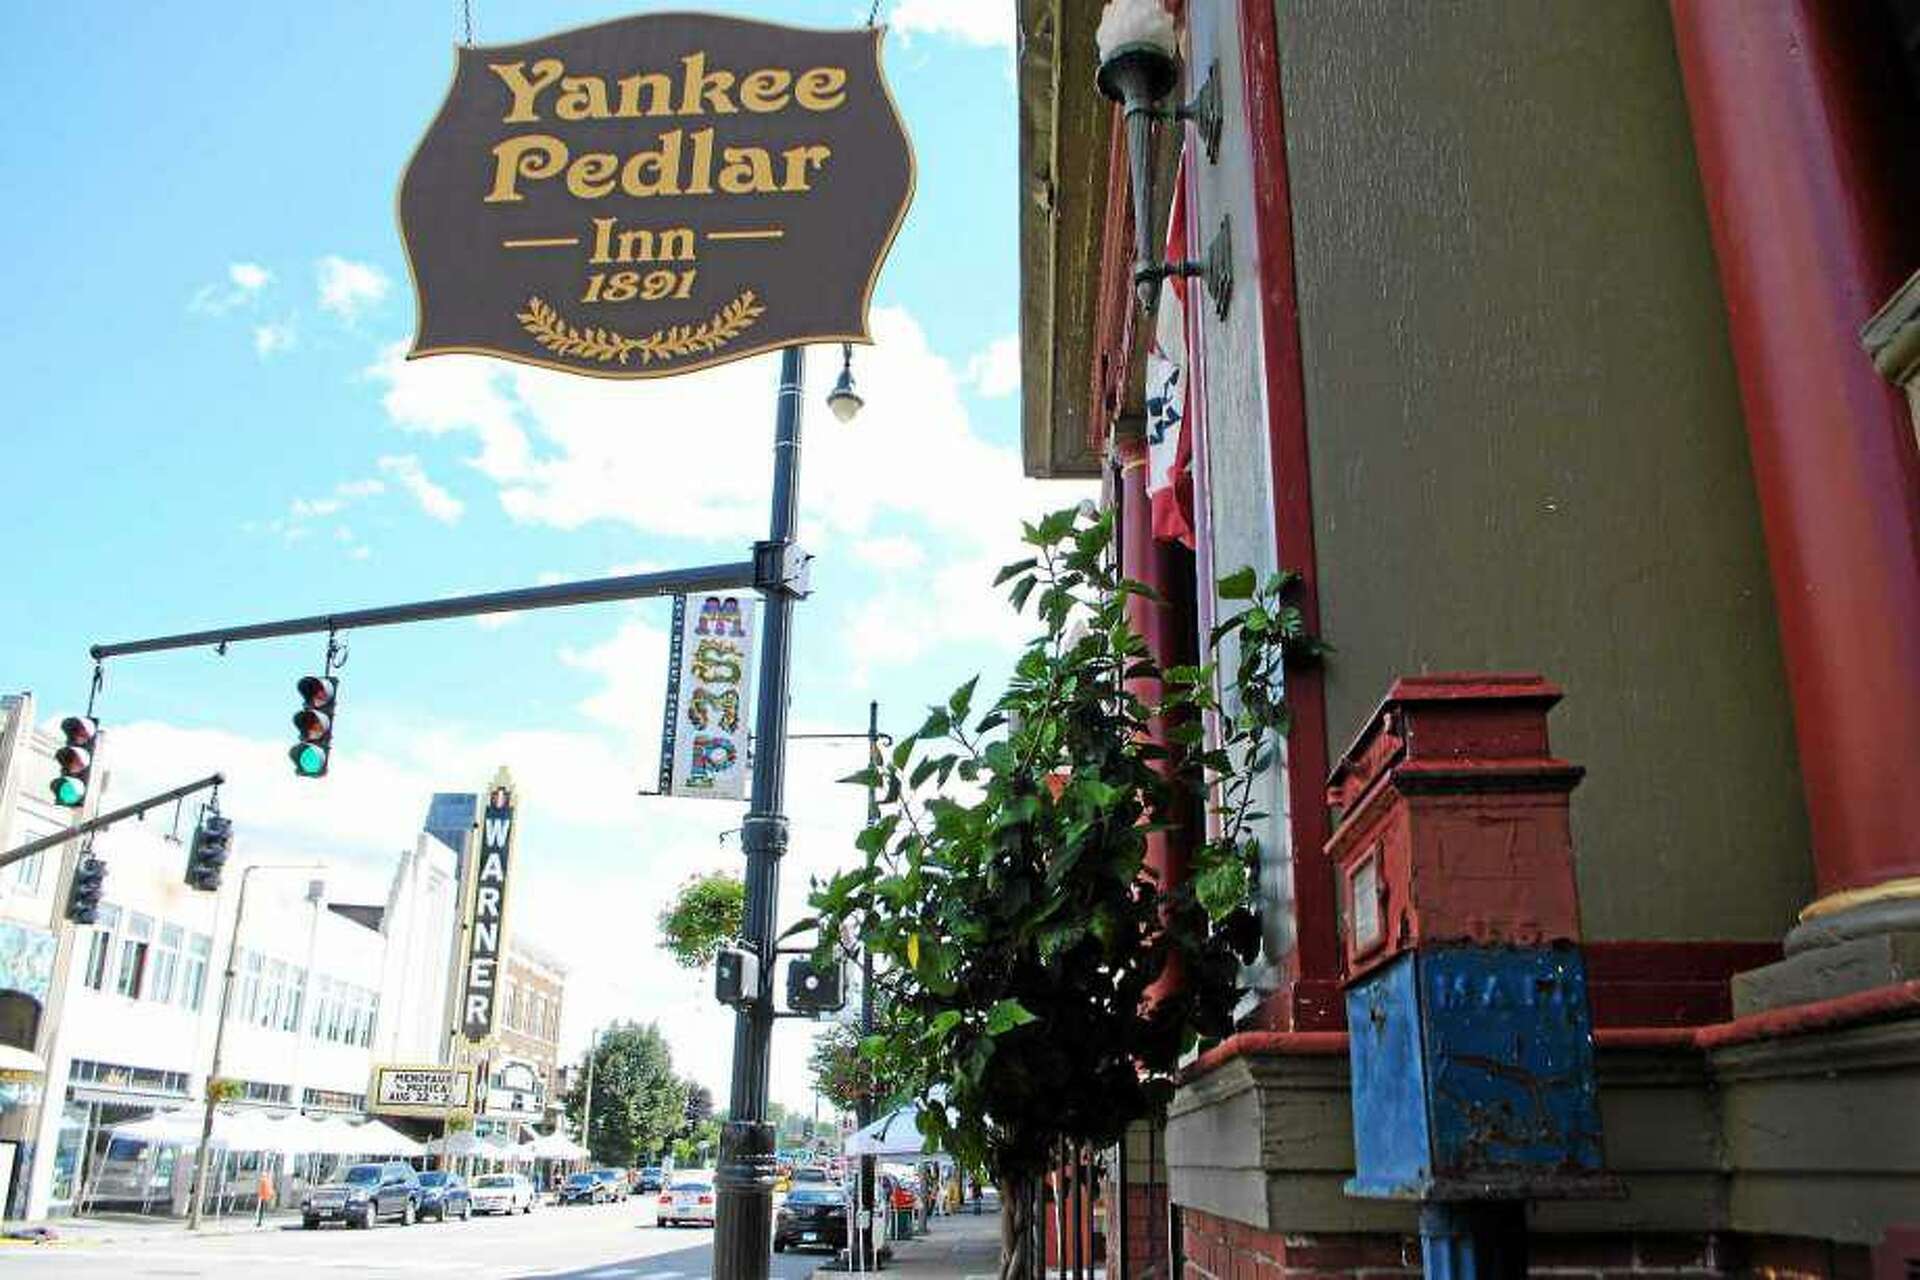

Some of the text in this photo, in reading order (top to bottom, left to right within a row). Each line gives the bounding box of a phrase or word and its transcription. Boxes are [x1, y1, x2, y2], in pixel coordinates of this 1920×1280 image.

[487, 50, 849, 124] Yankee
[483, 128, 832, 203] Pedlar
[589, 215, 697, 264] Inn
[581, 267, 697, 303] 1891
[466, 817, 510, 1025] WARNER
[389, 1092, 410, 1101] AUG
